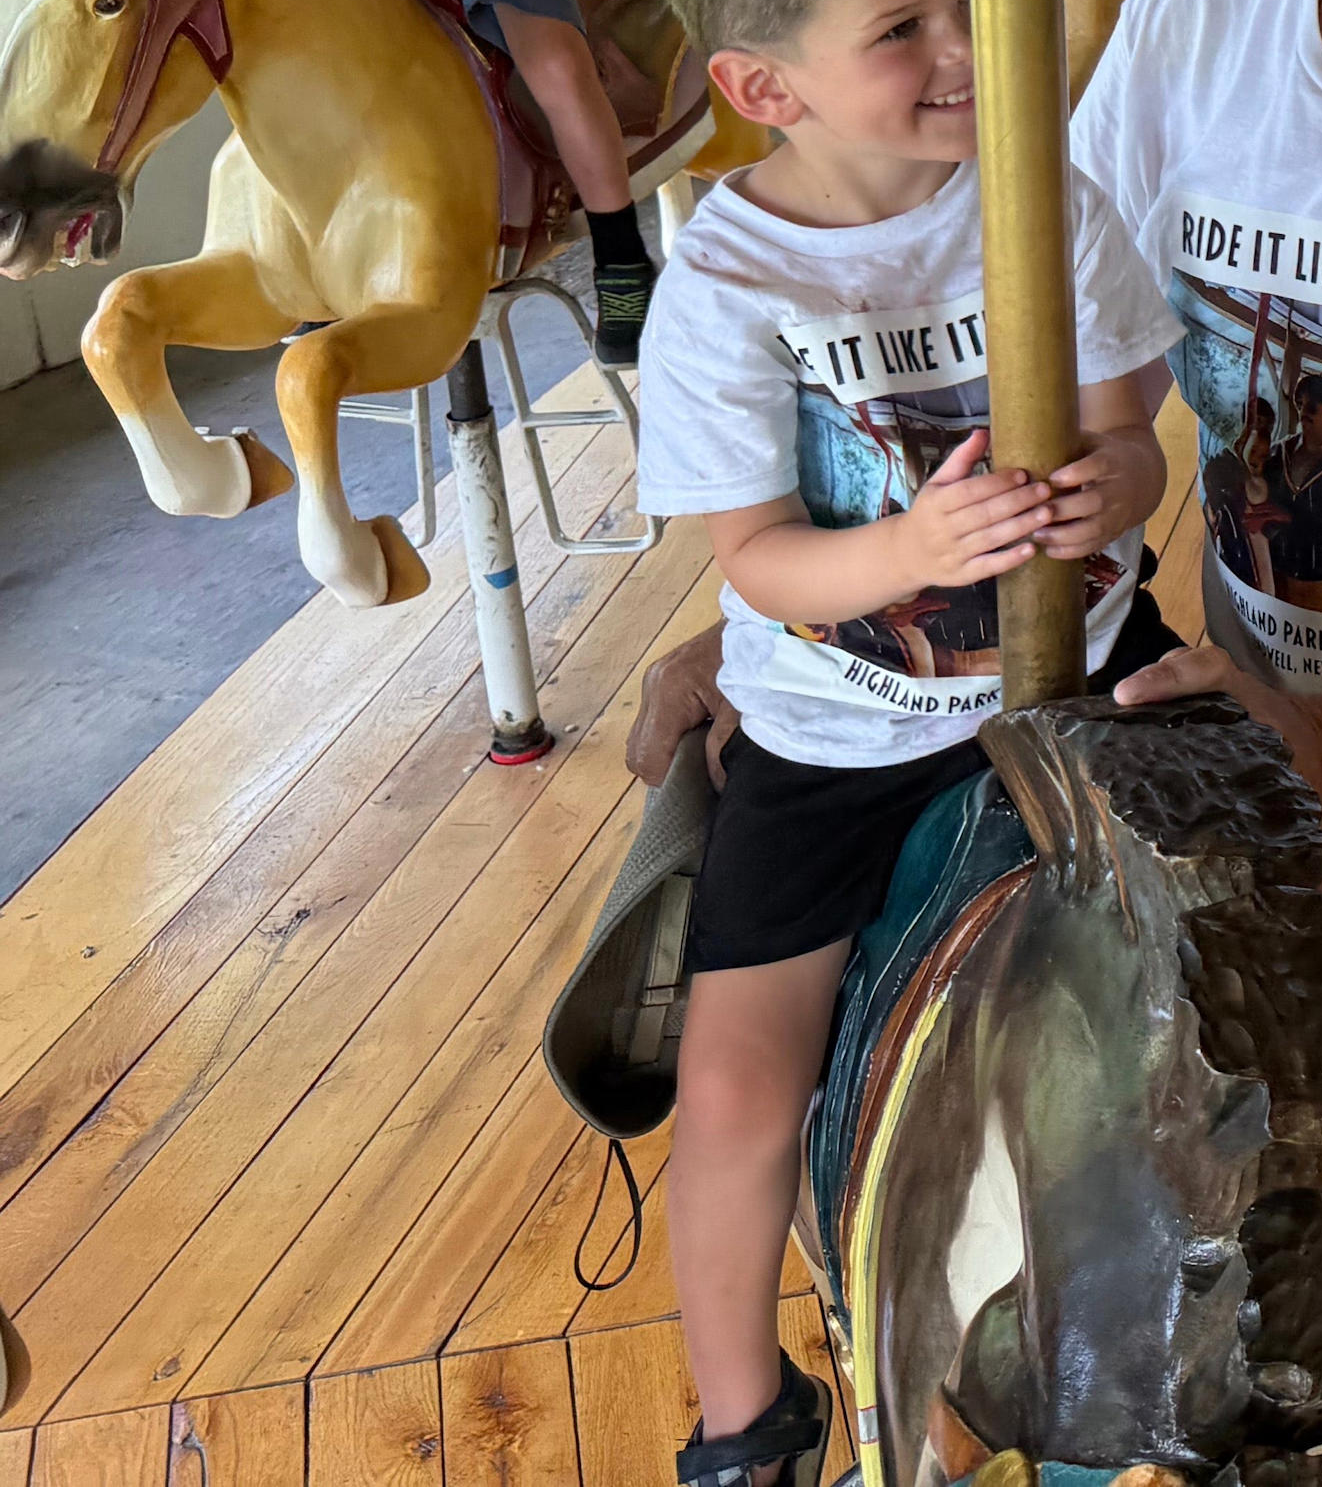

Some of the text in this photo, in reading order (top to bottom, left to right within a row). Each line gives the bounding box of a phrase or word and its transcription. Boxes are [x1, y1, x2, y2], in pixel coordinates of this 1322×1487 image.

[1182, 210, 1243, 268] RIDE
[1252, 229, 1286, 275] IT
[826, 335, 866, 386] IT
[875, 325, 939, 374] LIKE
[844, 658, 939, 713] HIGHLAND
